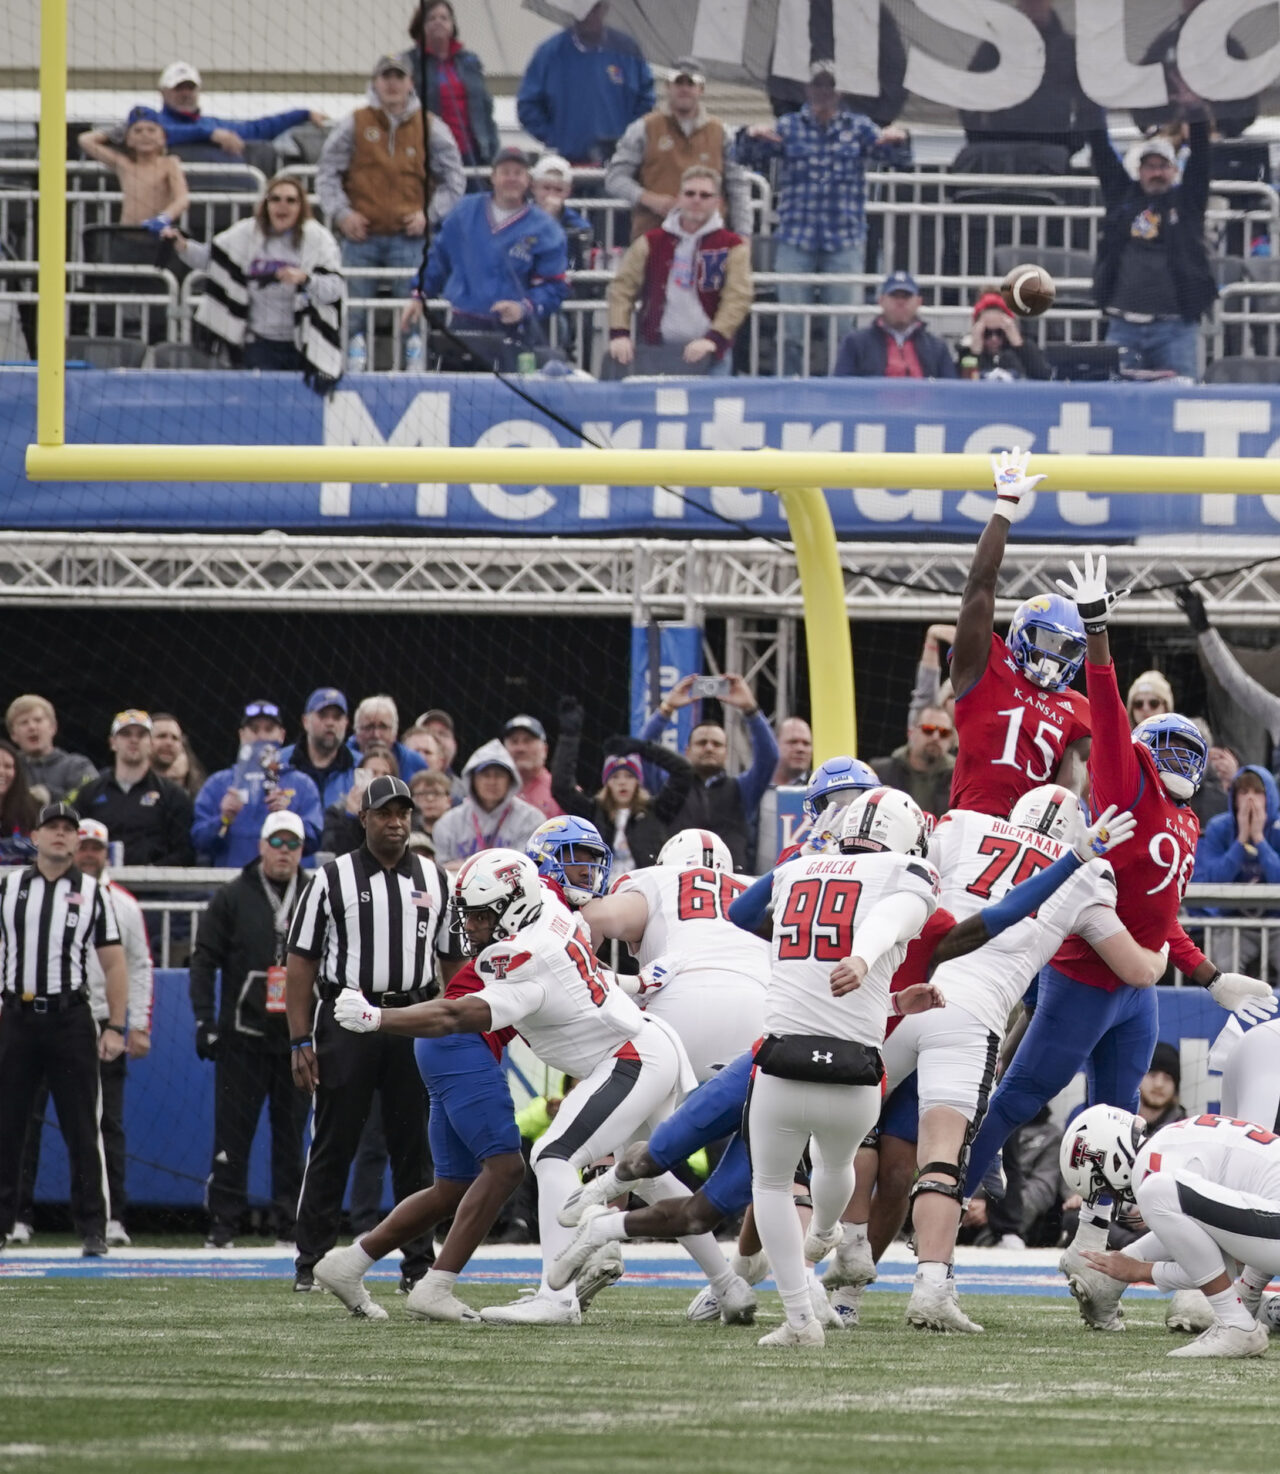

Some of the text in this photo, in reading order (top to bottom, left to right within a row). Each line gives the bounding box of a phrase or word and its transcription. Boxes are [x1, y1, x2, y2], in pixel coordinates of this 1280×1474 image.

[1013, 688, 1065, 725] KANSAS
[991, 706, 1063, 782] 15
[992, 821, 1063, 859] BUCHANAN
[806, 860, 857, 875] GARCIA
[417, 920, 429, 939] S
[778, 878, 863, 962] 99
